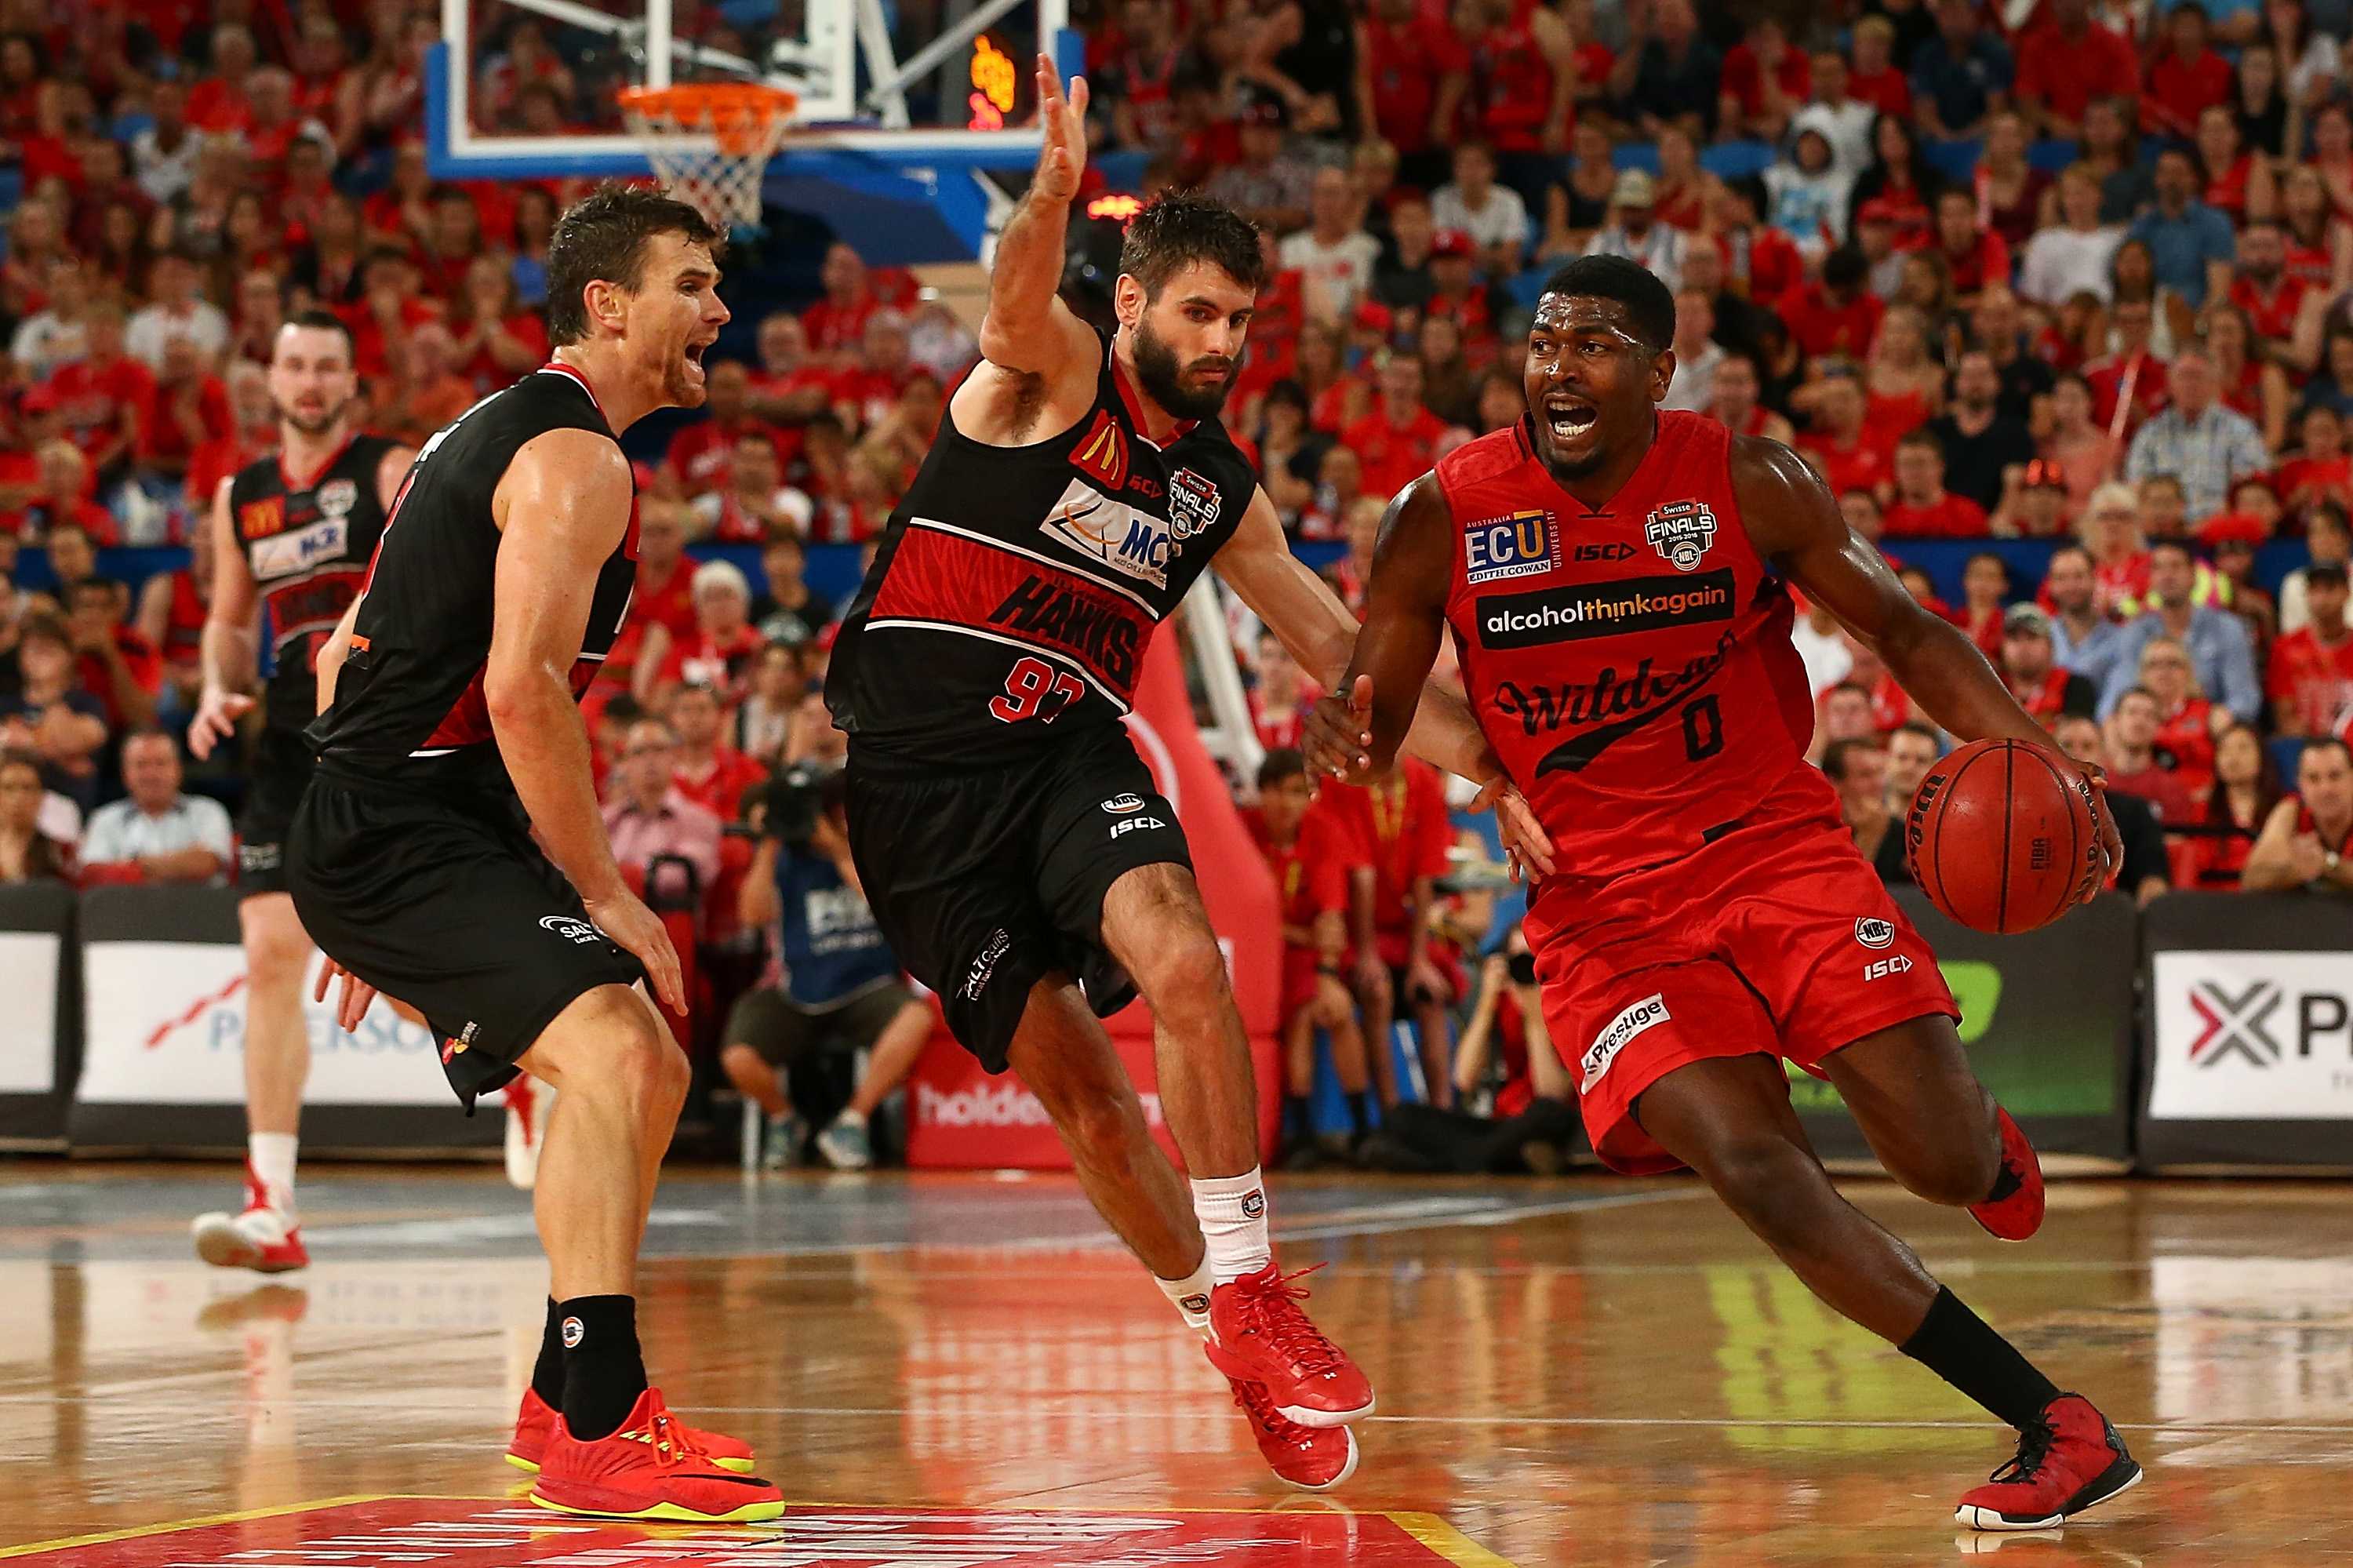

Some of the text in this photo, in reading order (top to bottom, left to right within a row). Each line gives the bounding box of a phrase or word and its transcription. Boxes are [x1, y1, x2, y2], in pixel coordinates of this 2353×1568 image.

[1171, 482, 1217, 519] FINALS
[1663, 504, 1691, 515] Swisse
[1466, 515, 1511, 529] AUSTRALIA
[1649, 515, 1713, 540] FINALS
[1118, 518, 1168, 575] MC
[1464, 519, 1544, 569] ECU
[1545, 511, 1562, 569] UNIVERSITY
[1678, 550, 1694, 563] NBL
[1468, 561, 1549, 582] EDITH COWAN
[986, 573, 1140, 692] HAWKS
[987, 656, 1086, 725] 97
[1110, 817, 1149, 839] ISC
[1862, 921, 1888, 940] NBL
[1864, 956, 1902, 982] ISC
[1591, 1001, 1662, 1064] Prestige
